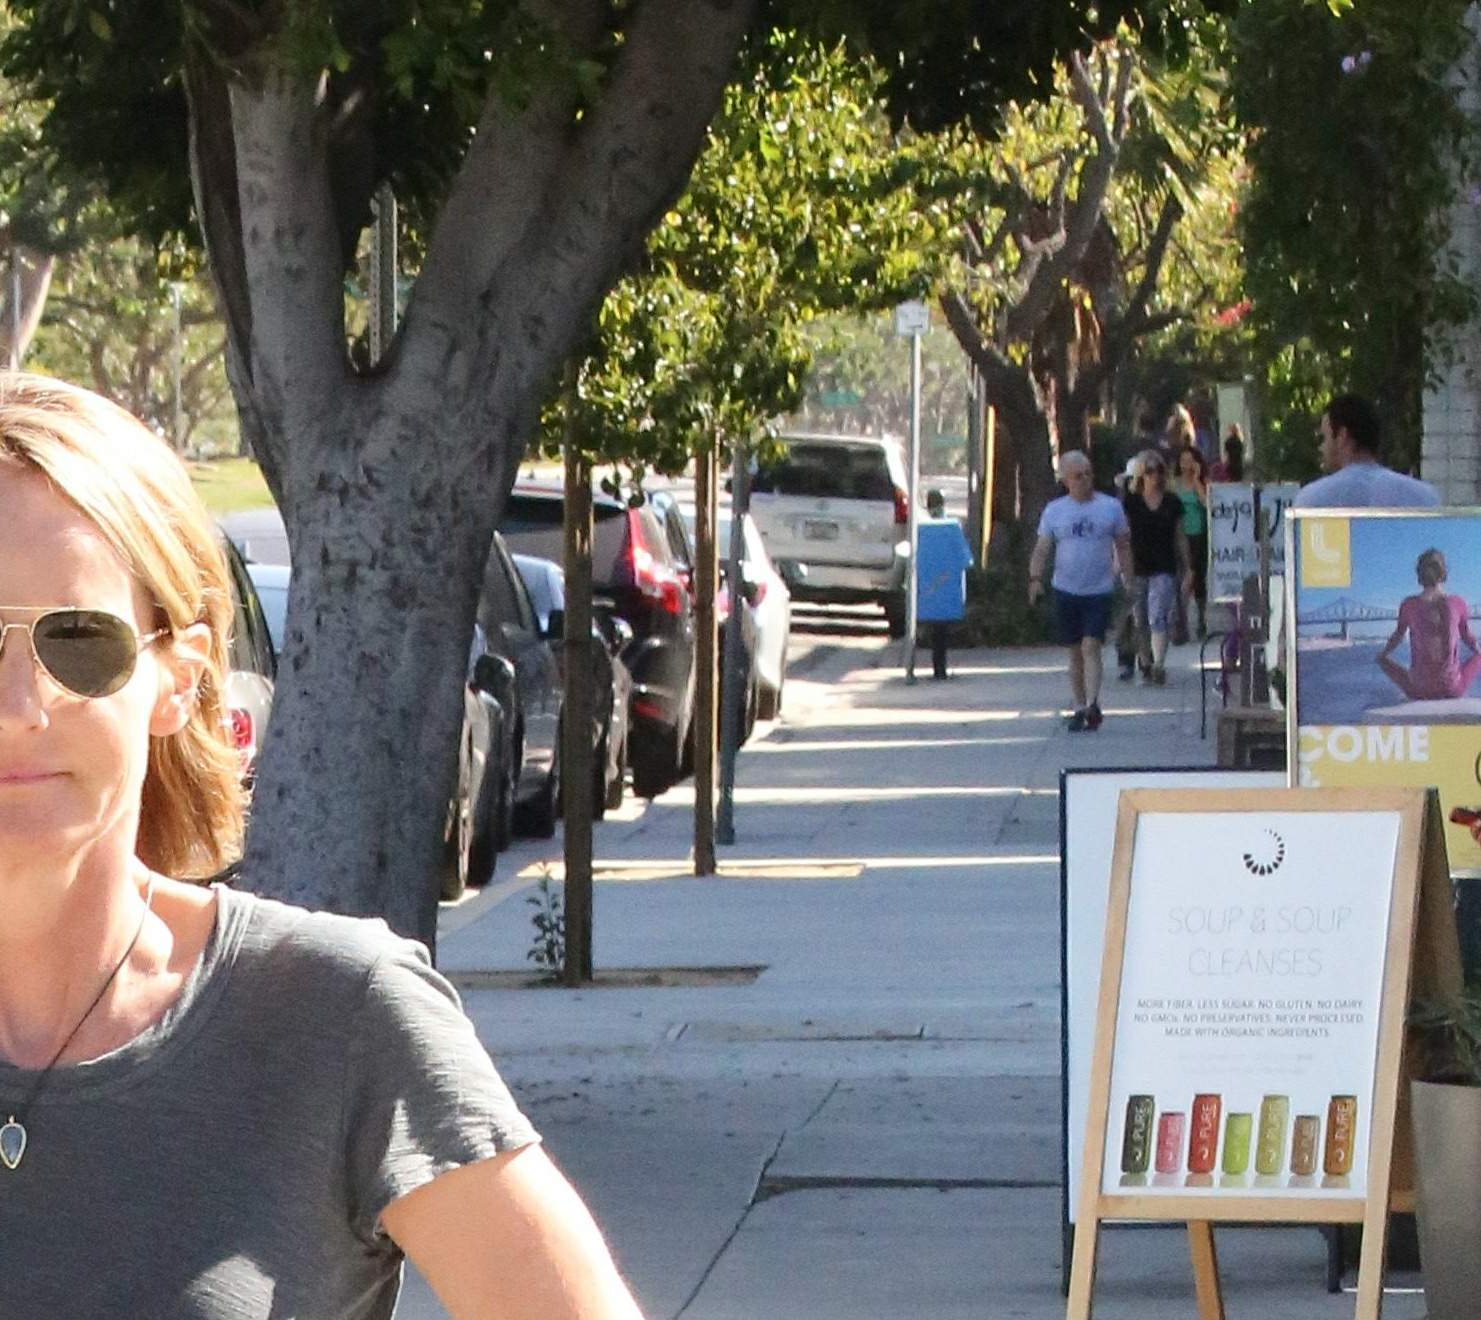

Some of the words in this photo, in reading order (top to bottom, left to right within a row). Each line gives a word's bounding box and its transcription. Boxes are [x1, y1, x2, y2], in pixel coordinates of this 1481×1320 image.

[1168, 906, 1243, 934] SOUP
[1250, 907, 1266, 933] &
[1277, 905, 1352, 934] SOUP
[1188, 948, 1322, 977] CLEANSES
[1132, 1103, 1147, 1139] PURE
[1199, 1103, 1212, 1139] PURE
[1335, 1103, 1351, 1141] PURE
